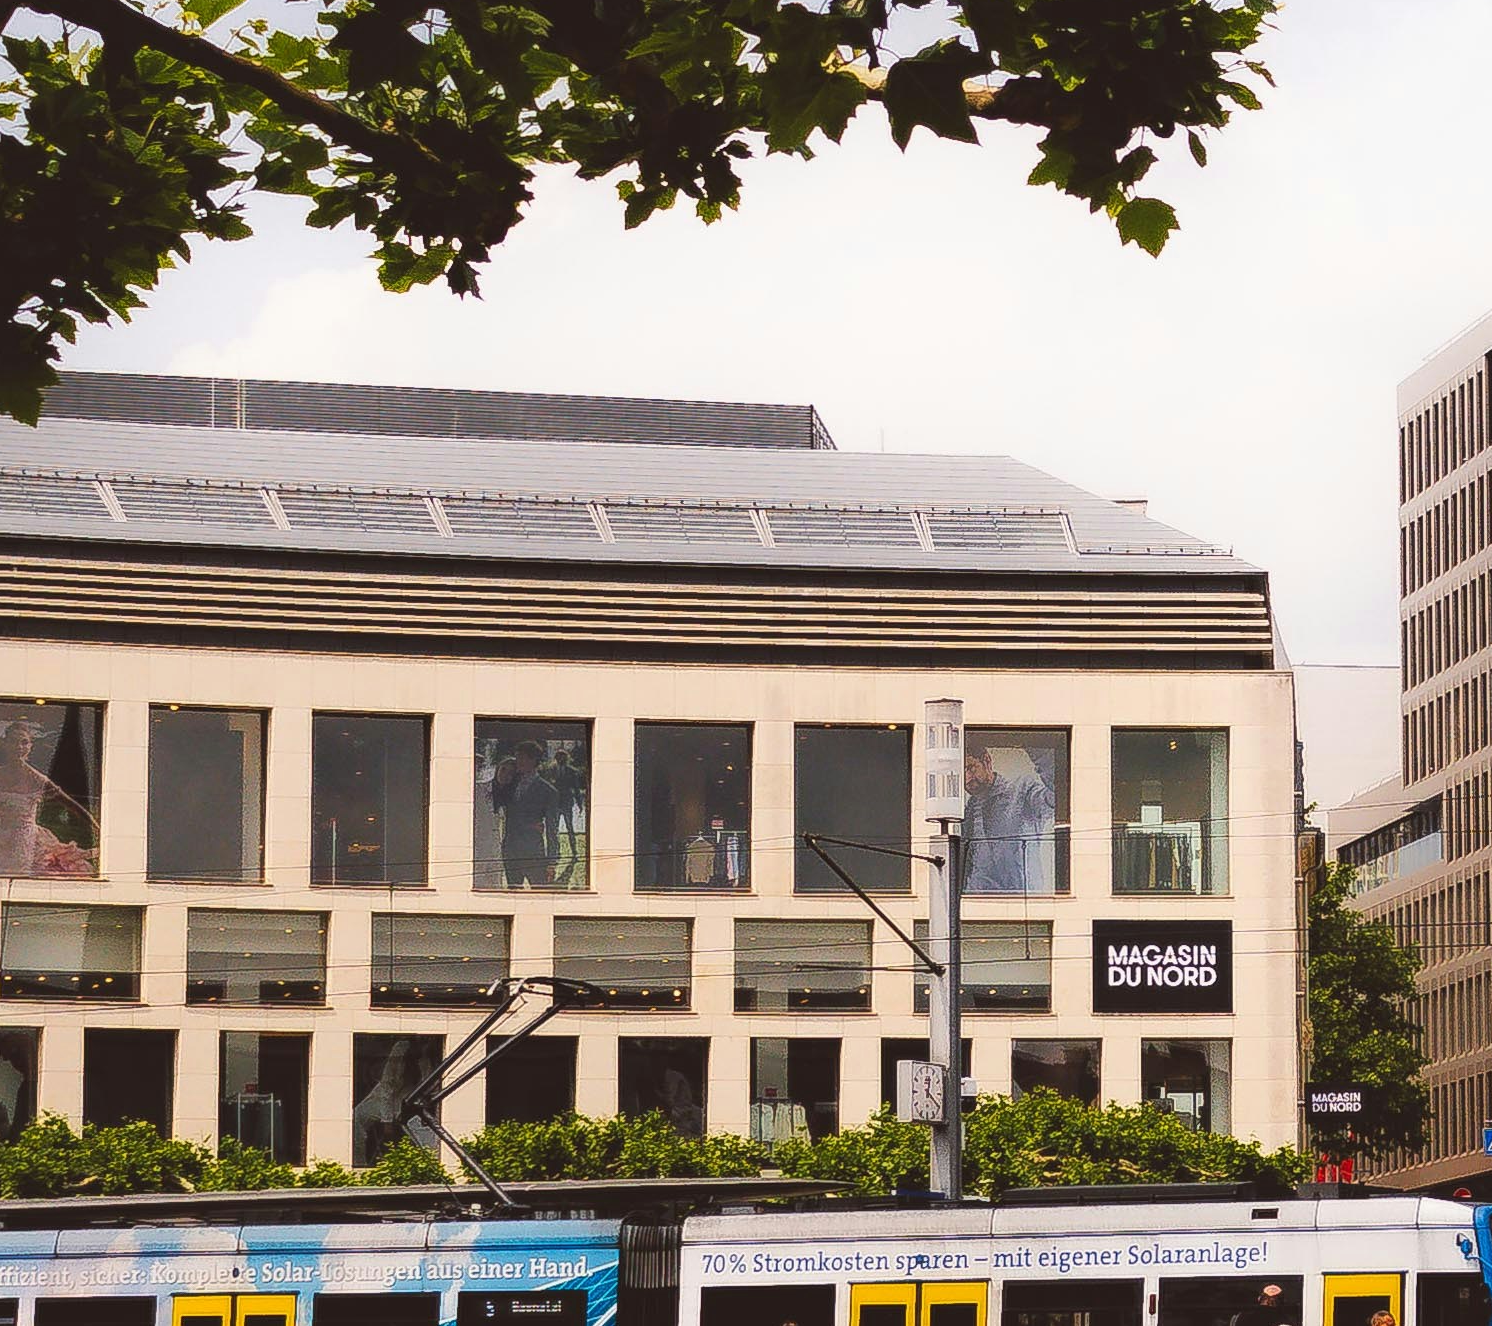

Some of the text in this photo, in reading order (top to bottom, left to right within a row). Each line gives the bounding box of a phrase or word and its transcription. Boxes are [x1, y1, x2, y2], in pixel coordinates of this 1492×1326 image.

[1107, 944, 1217, 966] MAGASIN
[1108, 965, 1218, 987] DU NORD
[1311, 1091, 1362, 1103] MAGASIN
[1312, 1102, 1362, 1113] DU NORD
[752, 1251, 890, 1273] Stromkosten
[895, 1251, 970, 1276] sparen
[993, 1246, 1033, 1268] mit
[1038, 1246, 1122, 1273] eigener
[1127, 1241, 1268, 1270] Solaranlage!
[80, 1264, 146, 1287] sicher:
[261, 1260, 420, 1288] Solar-Lösungen
[425, 1263, 465, 1281] aus
[467, 1257, 525, 1280] einer
[528, 1255, 595, 1279] Hand.
